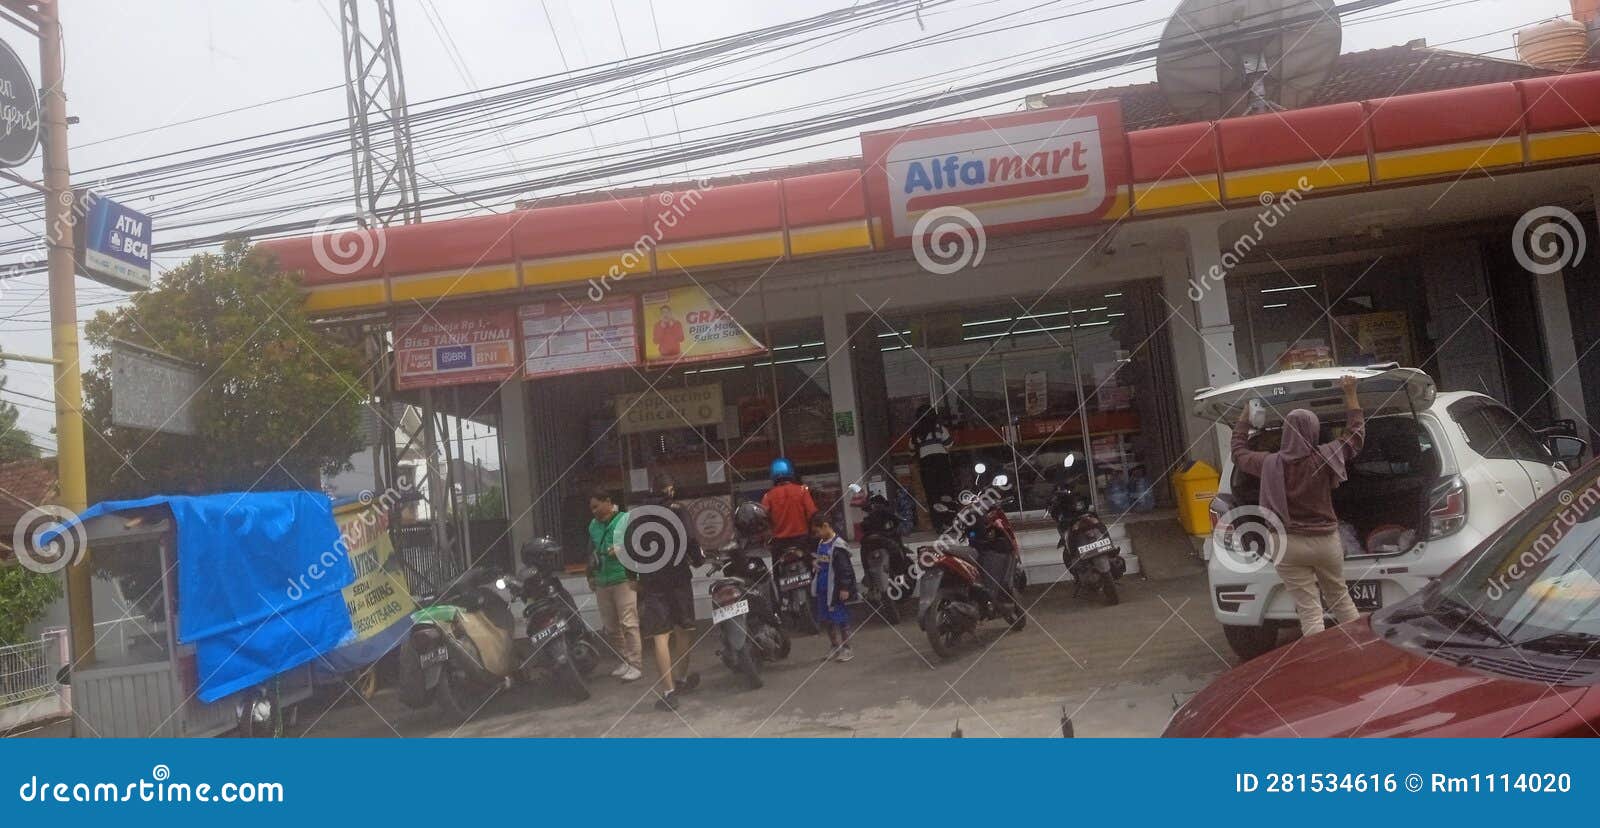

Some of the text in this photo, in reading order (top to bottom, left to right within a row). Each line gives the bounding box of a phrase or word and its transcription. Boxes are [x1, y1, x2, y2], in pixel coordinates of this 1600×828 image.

[904, 141, 1088, 194] Alfamart
[115, 214, 143, 238] ATM
[123, 237, 148, 260] BCA
[404, 328, 510, 348] Bisa TARIK TUNAI
[477, 351, 497, 363] BNI
[1353, 584, 1377, 600] SAV
